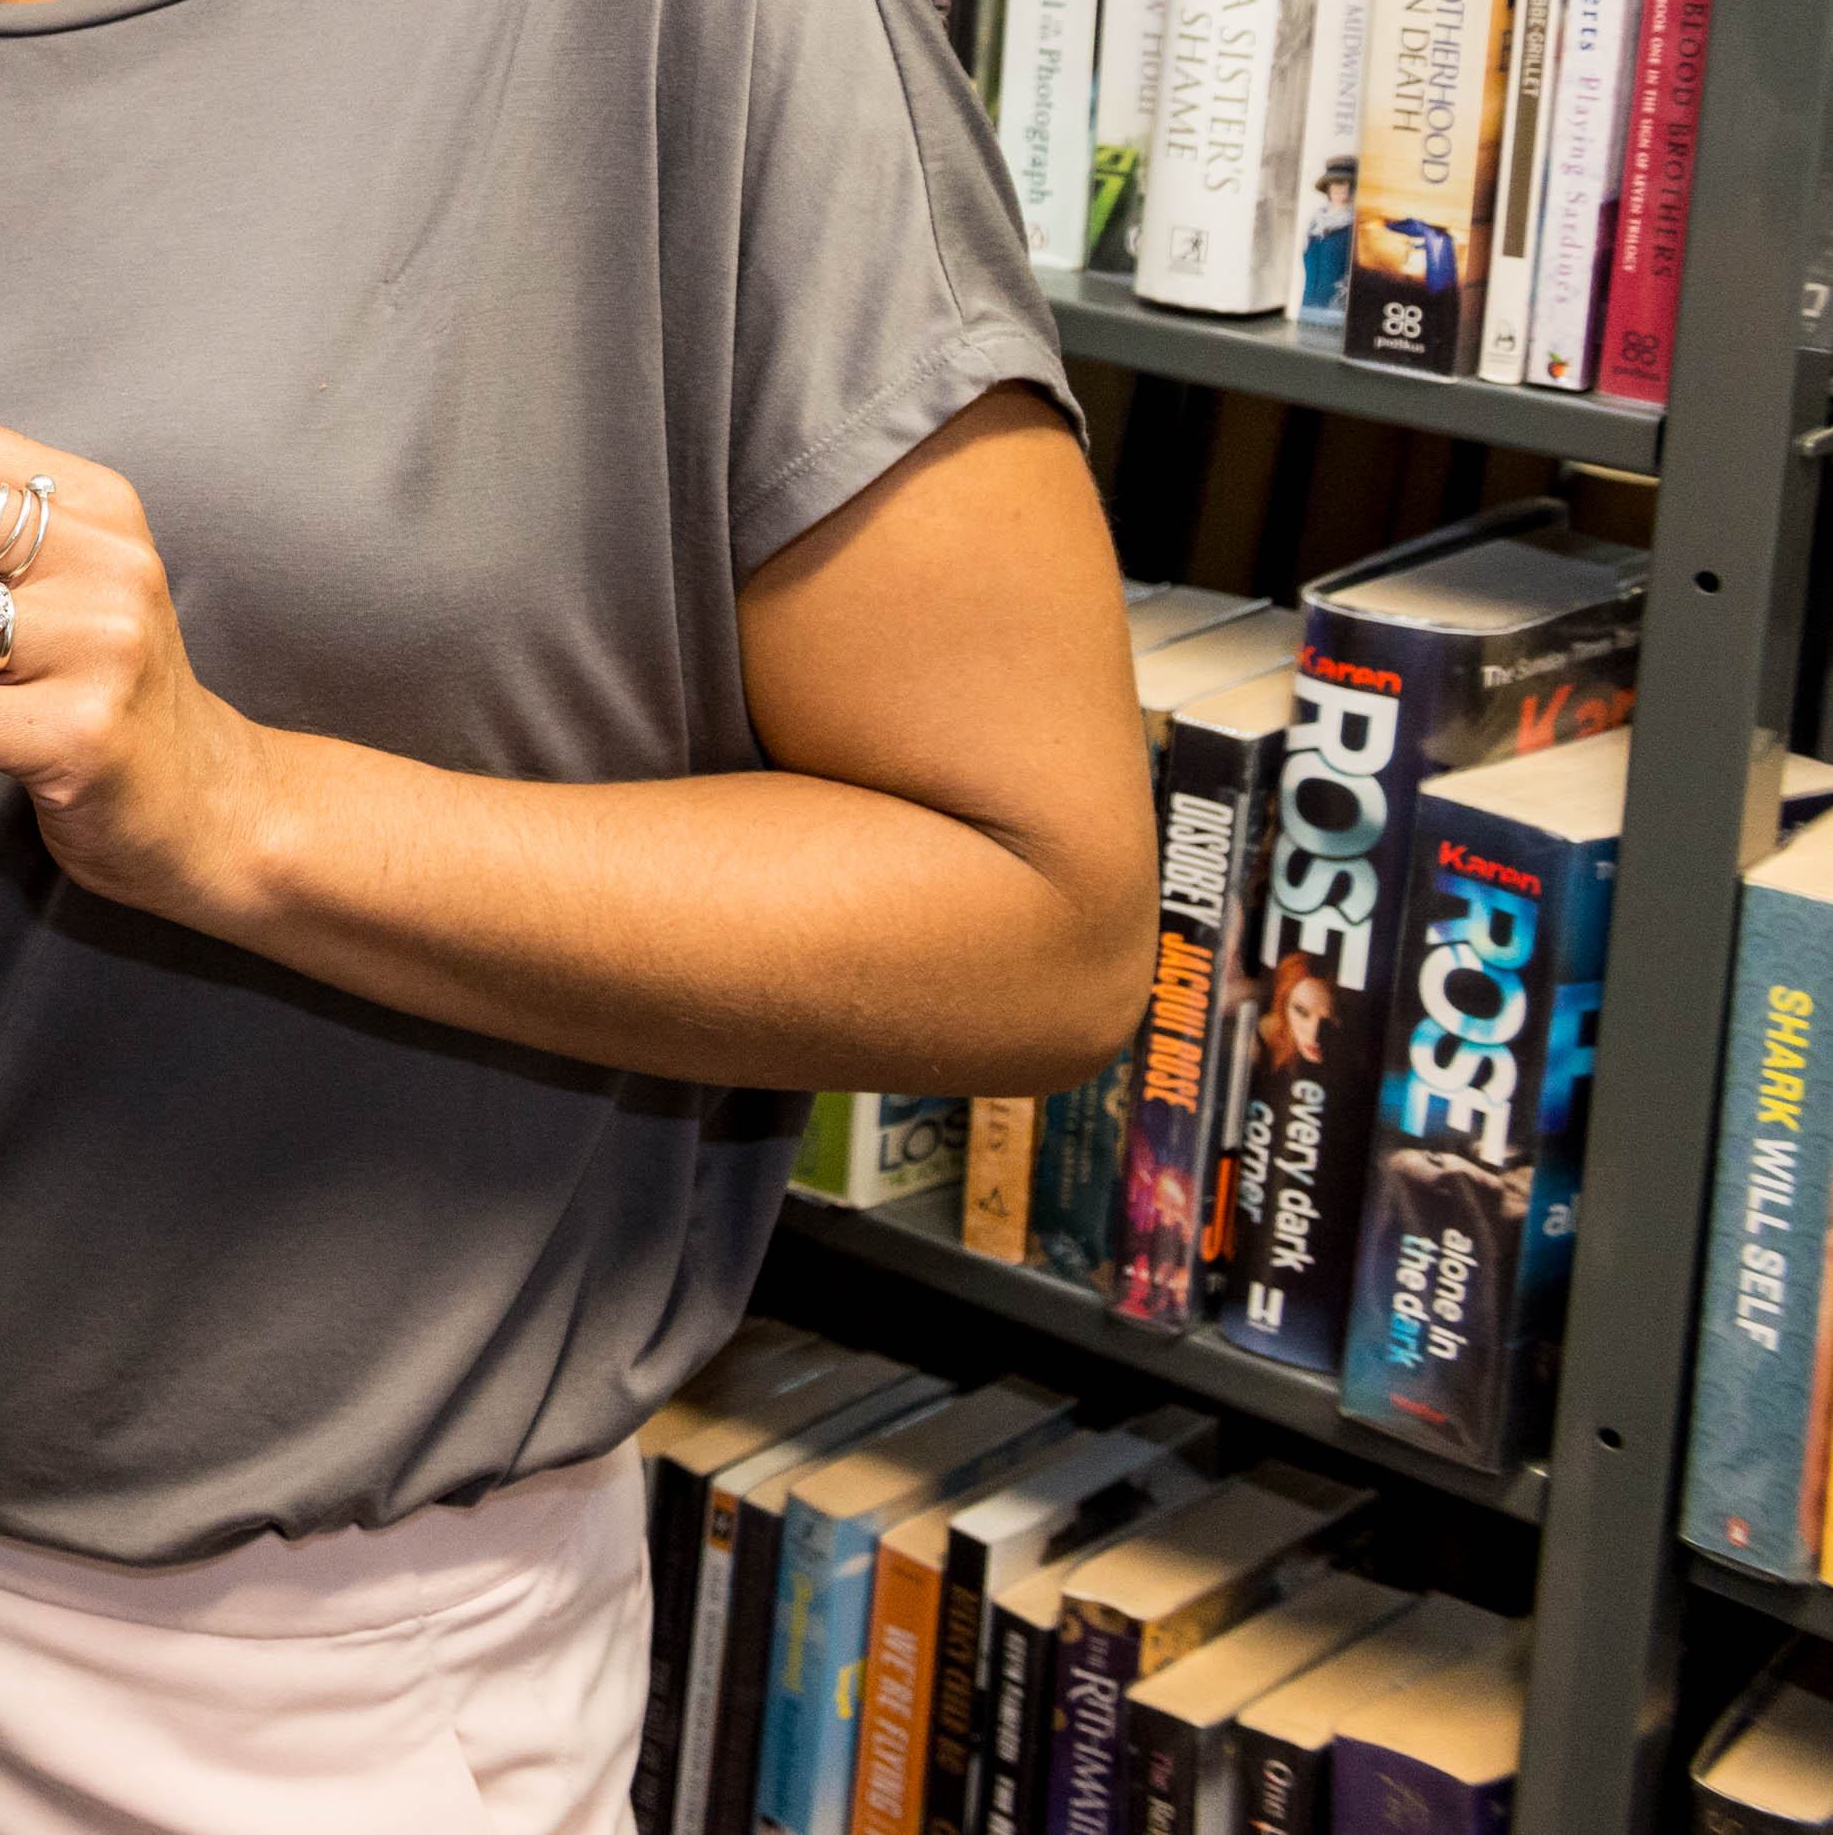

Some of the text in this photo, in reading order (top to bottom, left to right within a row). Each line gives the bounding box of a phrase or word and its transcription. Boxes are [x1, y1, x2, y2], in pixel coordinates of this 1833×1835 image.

[1025, 47, 1062, 205] Photograph
[1166, 9, 1210, 161] SHAME
[1205, 27, 1256, 194] SISTER'S
[1333, 3, 1366, 137] MIDWINTER
[1392, 27, 1430, 133] DEATH
[1560, 76, 1601, 175] Playing
[1651, 2, 1705, 277] BLOOD BROTHERS
[1298, 644, 1403, 695] Karen
[1260, 674, 1401, 991] ROSE
[1437, 841, 1542, 896] Karen
[1143, 791, 1234, 1115] DISOBEY JACQUI ROSE
[1399, 869, 1541, 1168] ROSE
[1237, 1100, 1275, 1224] corner
[1272, 1078, 1326, 1273] every dark
[1734, 983, 1814, 1353] SHARK WILL SELF
[1385, 1233, 1438, 1368] the dark
[1426, 1228, 1479, 1362] alone in
